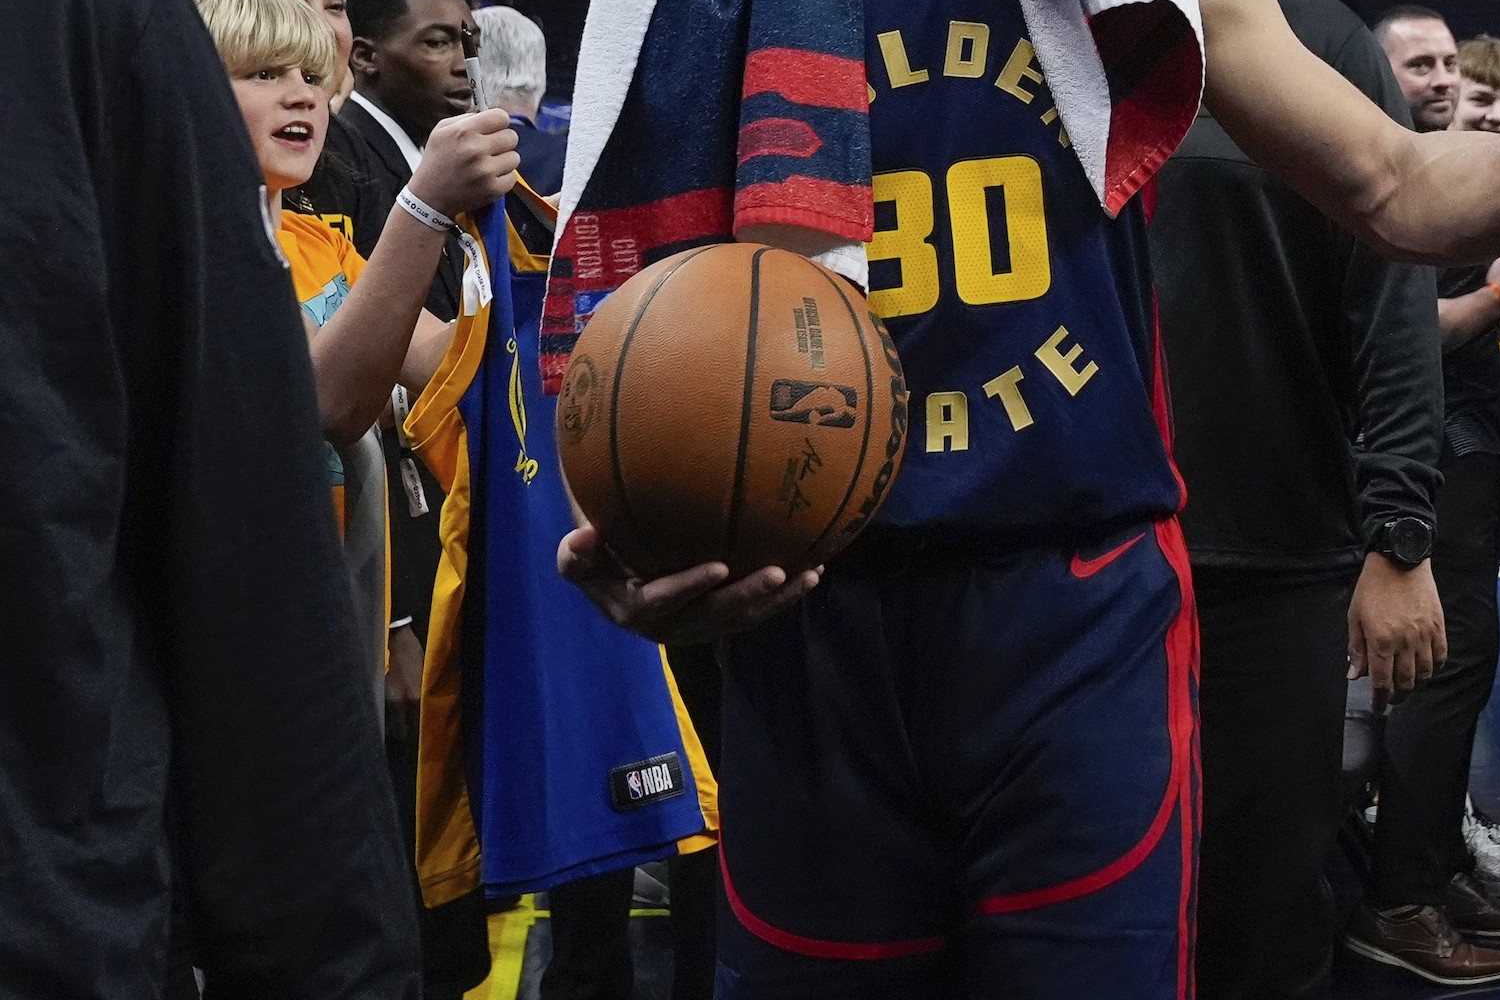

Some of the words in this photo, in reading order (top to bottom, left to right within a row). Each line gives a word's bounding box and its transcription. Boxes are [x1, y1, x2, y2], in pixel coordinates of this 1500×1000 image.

[573, 214, 603, 279] EDITION
[611, 238, 639, 274] CITY
[866, 154, 1052, 319] 30
[907, 325, 1100, 453] ATE
[640, 763, 674, 796] NBA
